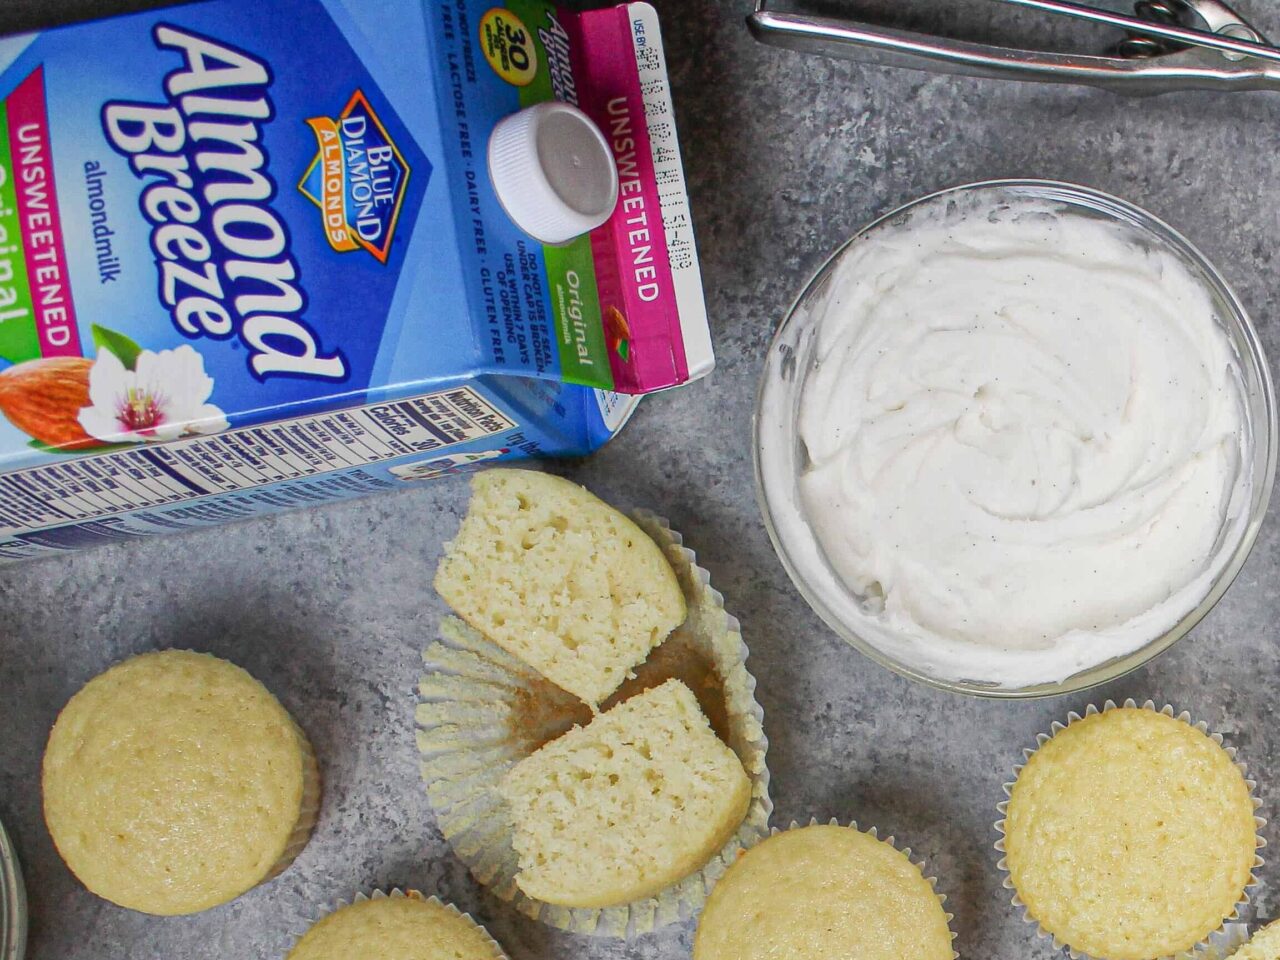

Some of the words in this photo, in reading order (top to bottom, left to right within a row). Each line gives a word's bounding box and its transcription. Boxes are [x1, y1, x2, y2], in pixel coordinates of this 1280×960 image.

[494, 16, 511, 72] CALORIES
[505, 24, 530, 71] 30
[633, 19, 645, 36] USE
[545, 11, 579, 107] Almon
[447, 54, 466, 118] LACTOSE
[458, 122, 473, 158] FREE
[320, 129, 348, 243] ALMONDS
[343, 115, 382, 241] DIAMOND
[366, 145, 395, 208] BLUE
[465, 170, 481, 215] DAIRY
[606, 96, 660, 302] UNSWEETENED
[84, 160, 121, 285] almondmilk
[103, 104, 233, 335] Breeze
[155, 25, 346, 378] Almond
[17, 123, 71, 347] UNSWEETENED
[473, 219, 487, 255] FREE
[496, 271, 508, 288] OF
[503, 253, 515, 276] USE
[517, 240, 531, 280] UNDER
[527, 253, 538, 271] DO
[480, 268, 498, 324] GLUTEN
[508, 279, 523, 322] WITHIN
[524, 284, 535, 309] CAP
[531, 273, 542, 297] NOT
[500, 290, 517, 344] OPENING
[529, 311, 537, 322] IS
[535, 300, 546, 322] USE
[556, 283, 572, 345] almondmilk
[566, 270, 594, 365] Original
[491, 329, 506, 364] FREE
[517, 334, 530, 365] DAYS
[530, 324, 545, 377] BROKEN.
[541, 339, 553, 366] SEAL
[370, 406, 411, 436] Calories
[411, 438, 442, 451] 30
[481, 415, 504, 432] Facts
